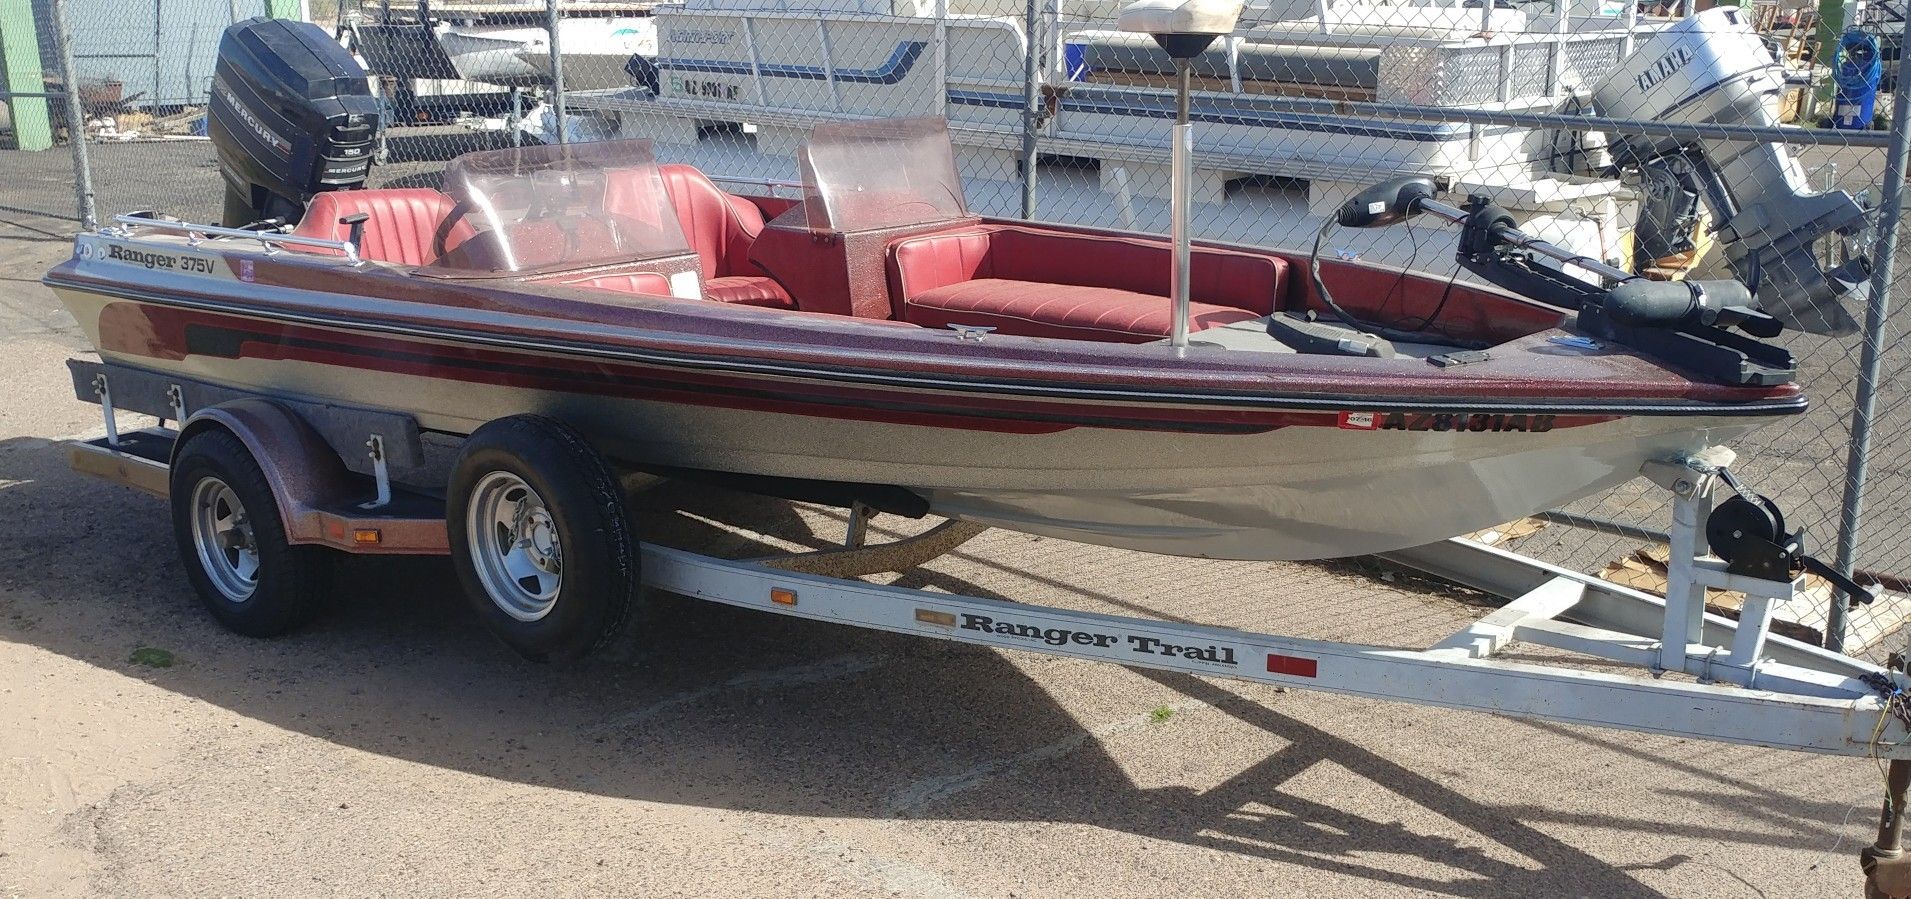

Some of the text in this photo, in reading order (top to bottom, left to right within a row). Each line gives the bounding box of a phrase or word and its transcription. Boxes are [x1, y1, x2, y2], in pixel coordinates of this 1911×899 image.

[1633, 44, 1694, 92] YAMAHA
[225, 92, 280, 148] MERCURY
[344, 148, 361, 156] 150
[108, 244, 176, 270] Ranger
[181, 256, 215, 275] 375V
[960, 612, 1239, 665] Ranger Trail
